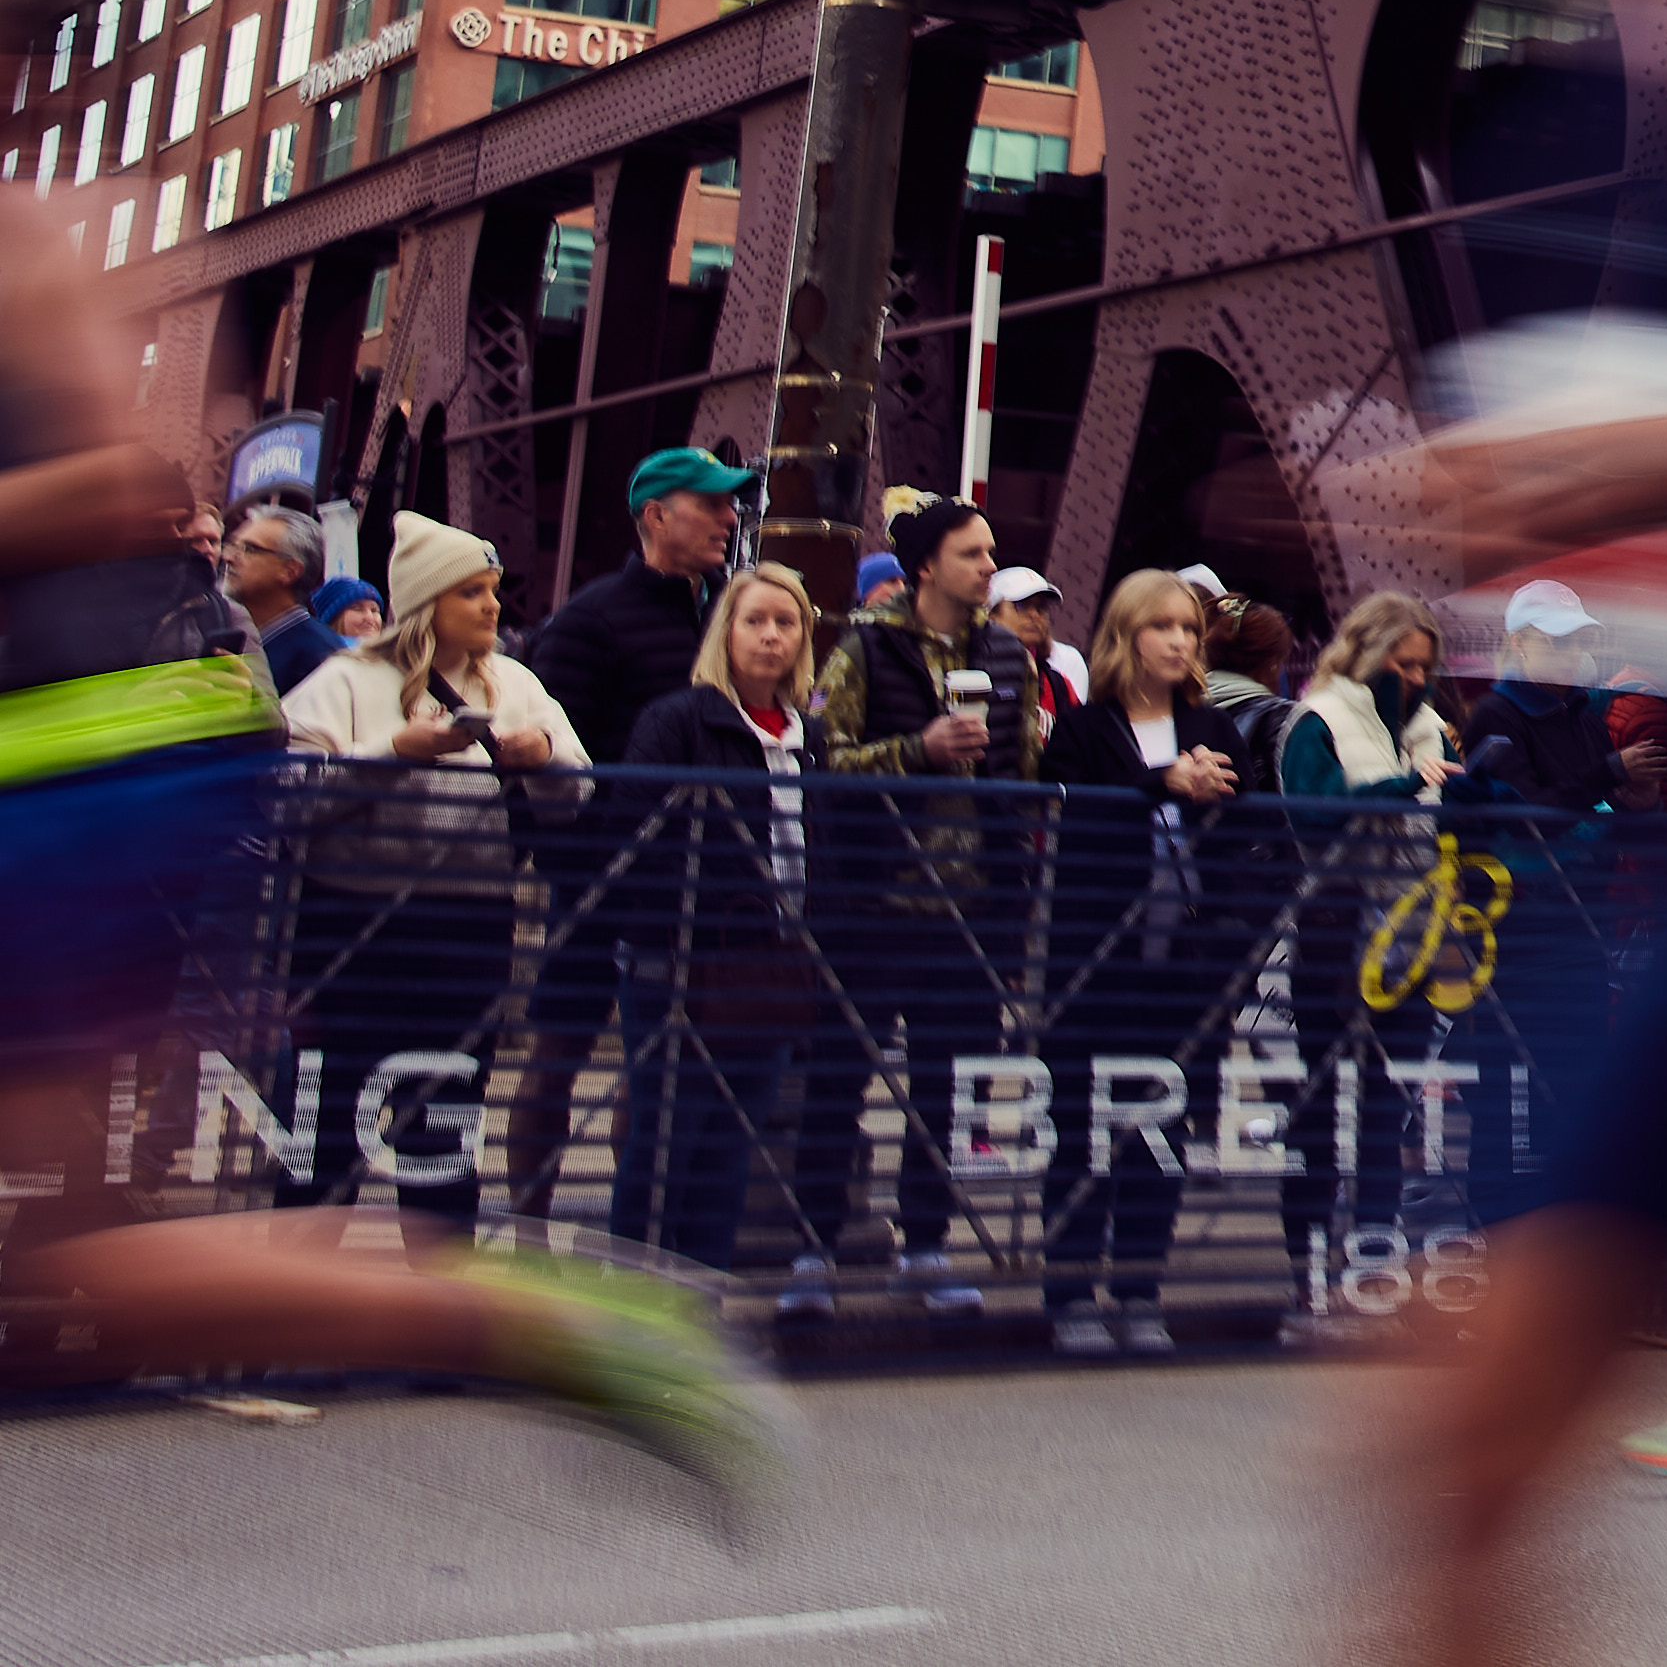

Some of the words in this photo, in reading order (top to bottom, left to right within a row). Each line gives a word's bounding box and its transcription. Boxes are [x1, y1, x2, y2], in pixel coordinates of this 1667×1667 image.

[498, 13, 569, 62] The
[0, 1049, 488, 1187] ING
[949, 1055, 1548, 1177] BREITL
[1307, 1222, 1490, 1316] 188
